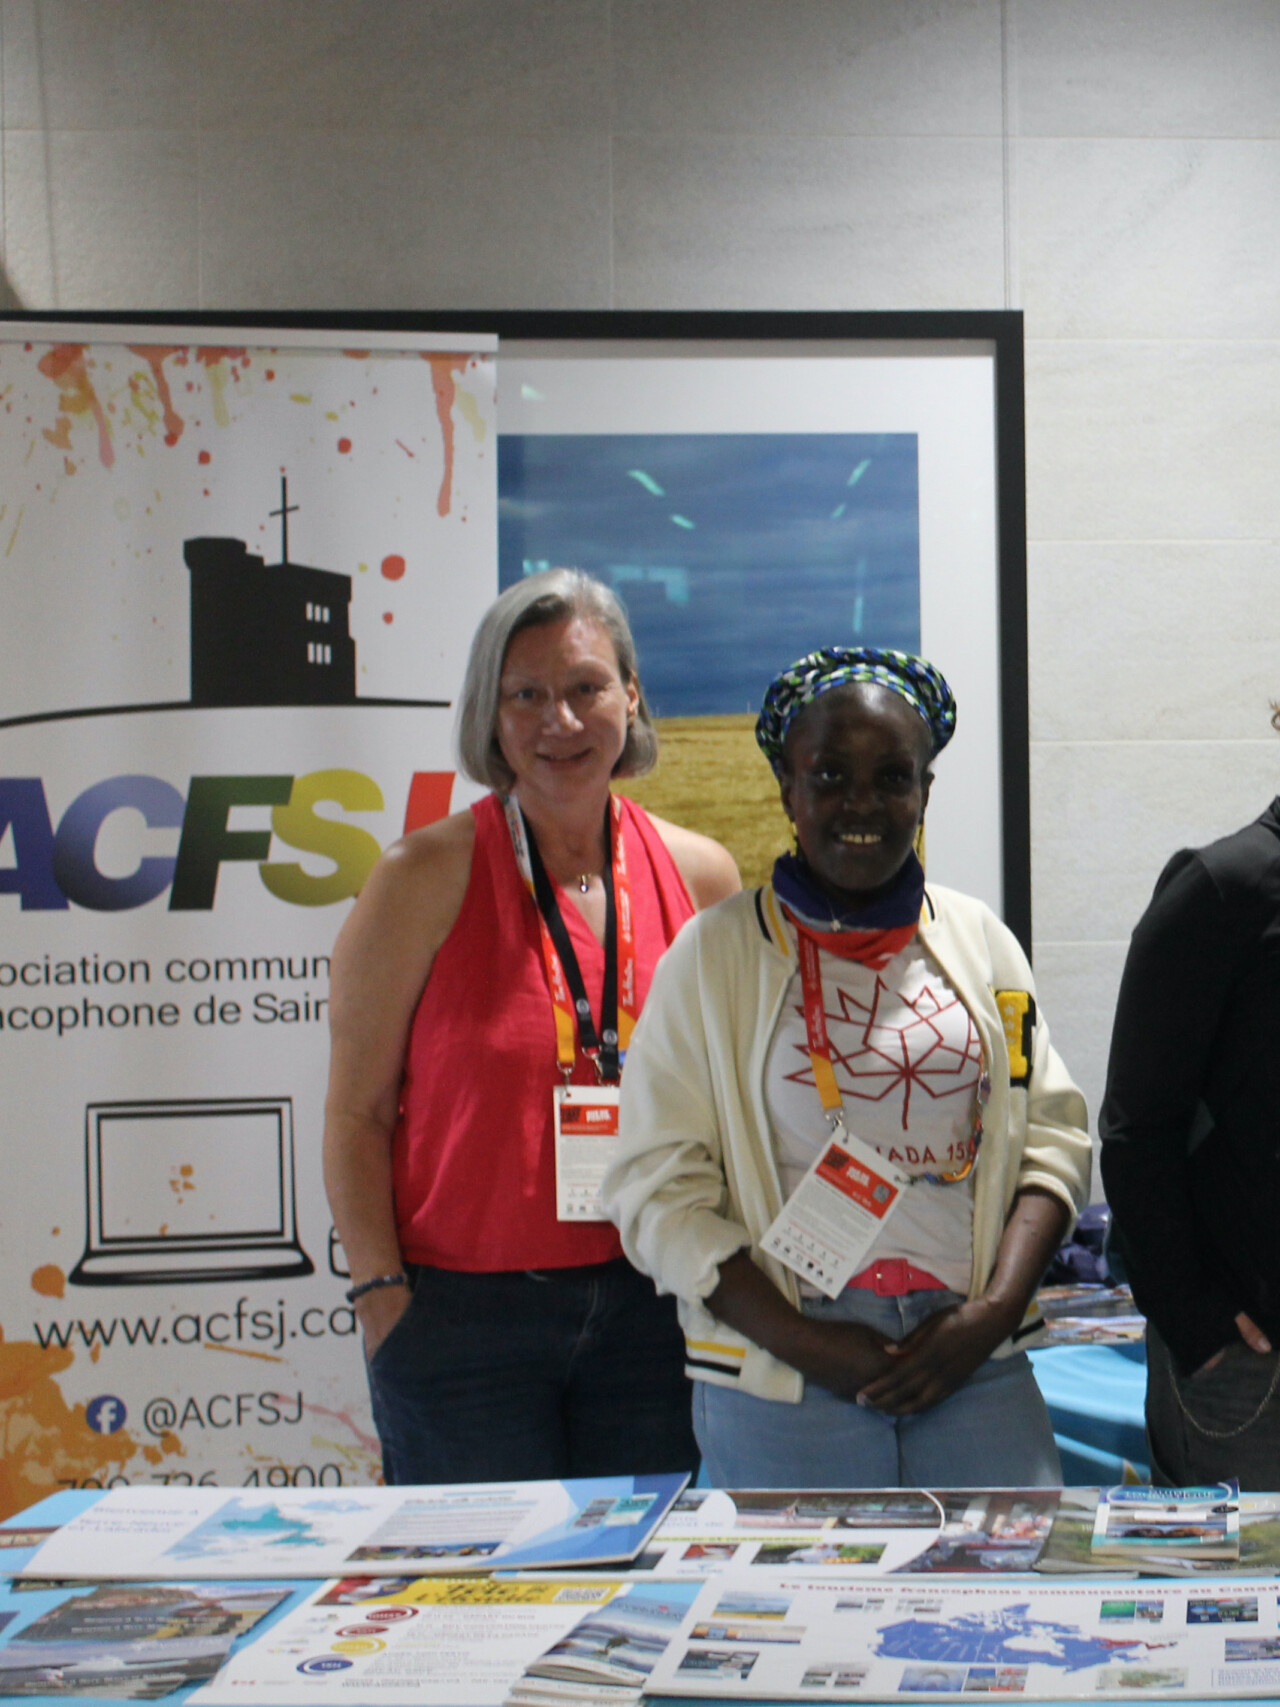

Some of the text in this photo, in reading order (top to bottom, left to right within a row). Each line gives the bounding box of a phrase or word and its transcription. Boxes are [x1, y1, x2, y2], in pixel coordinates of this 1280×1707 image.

[193, 995, 242, 1025] de
[34, 1298, 357, 1349] www.acfsj.ca
[144, 1391, 304, 1438] @ACFSJ
[808, 1583, 894, 1592] tourisme
[900, 1584, 1022, 1596] francophone
[1028, 1586, 1182, 1595] communautaire
